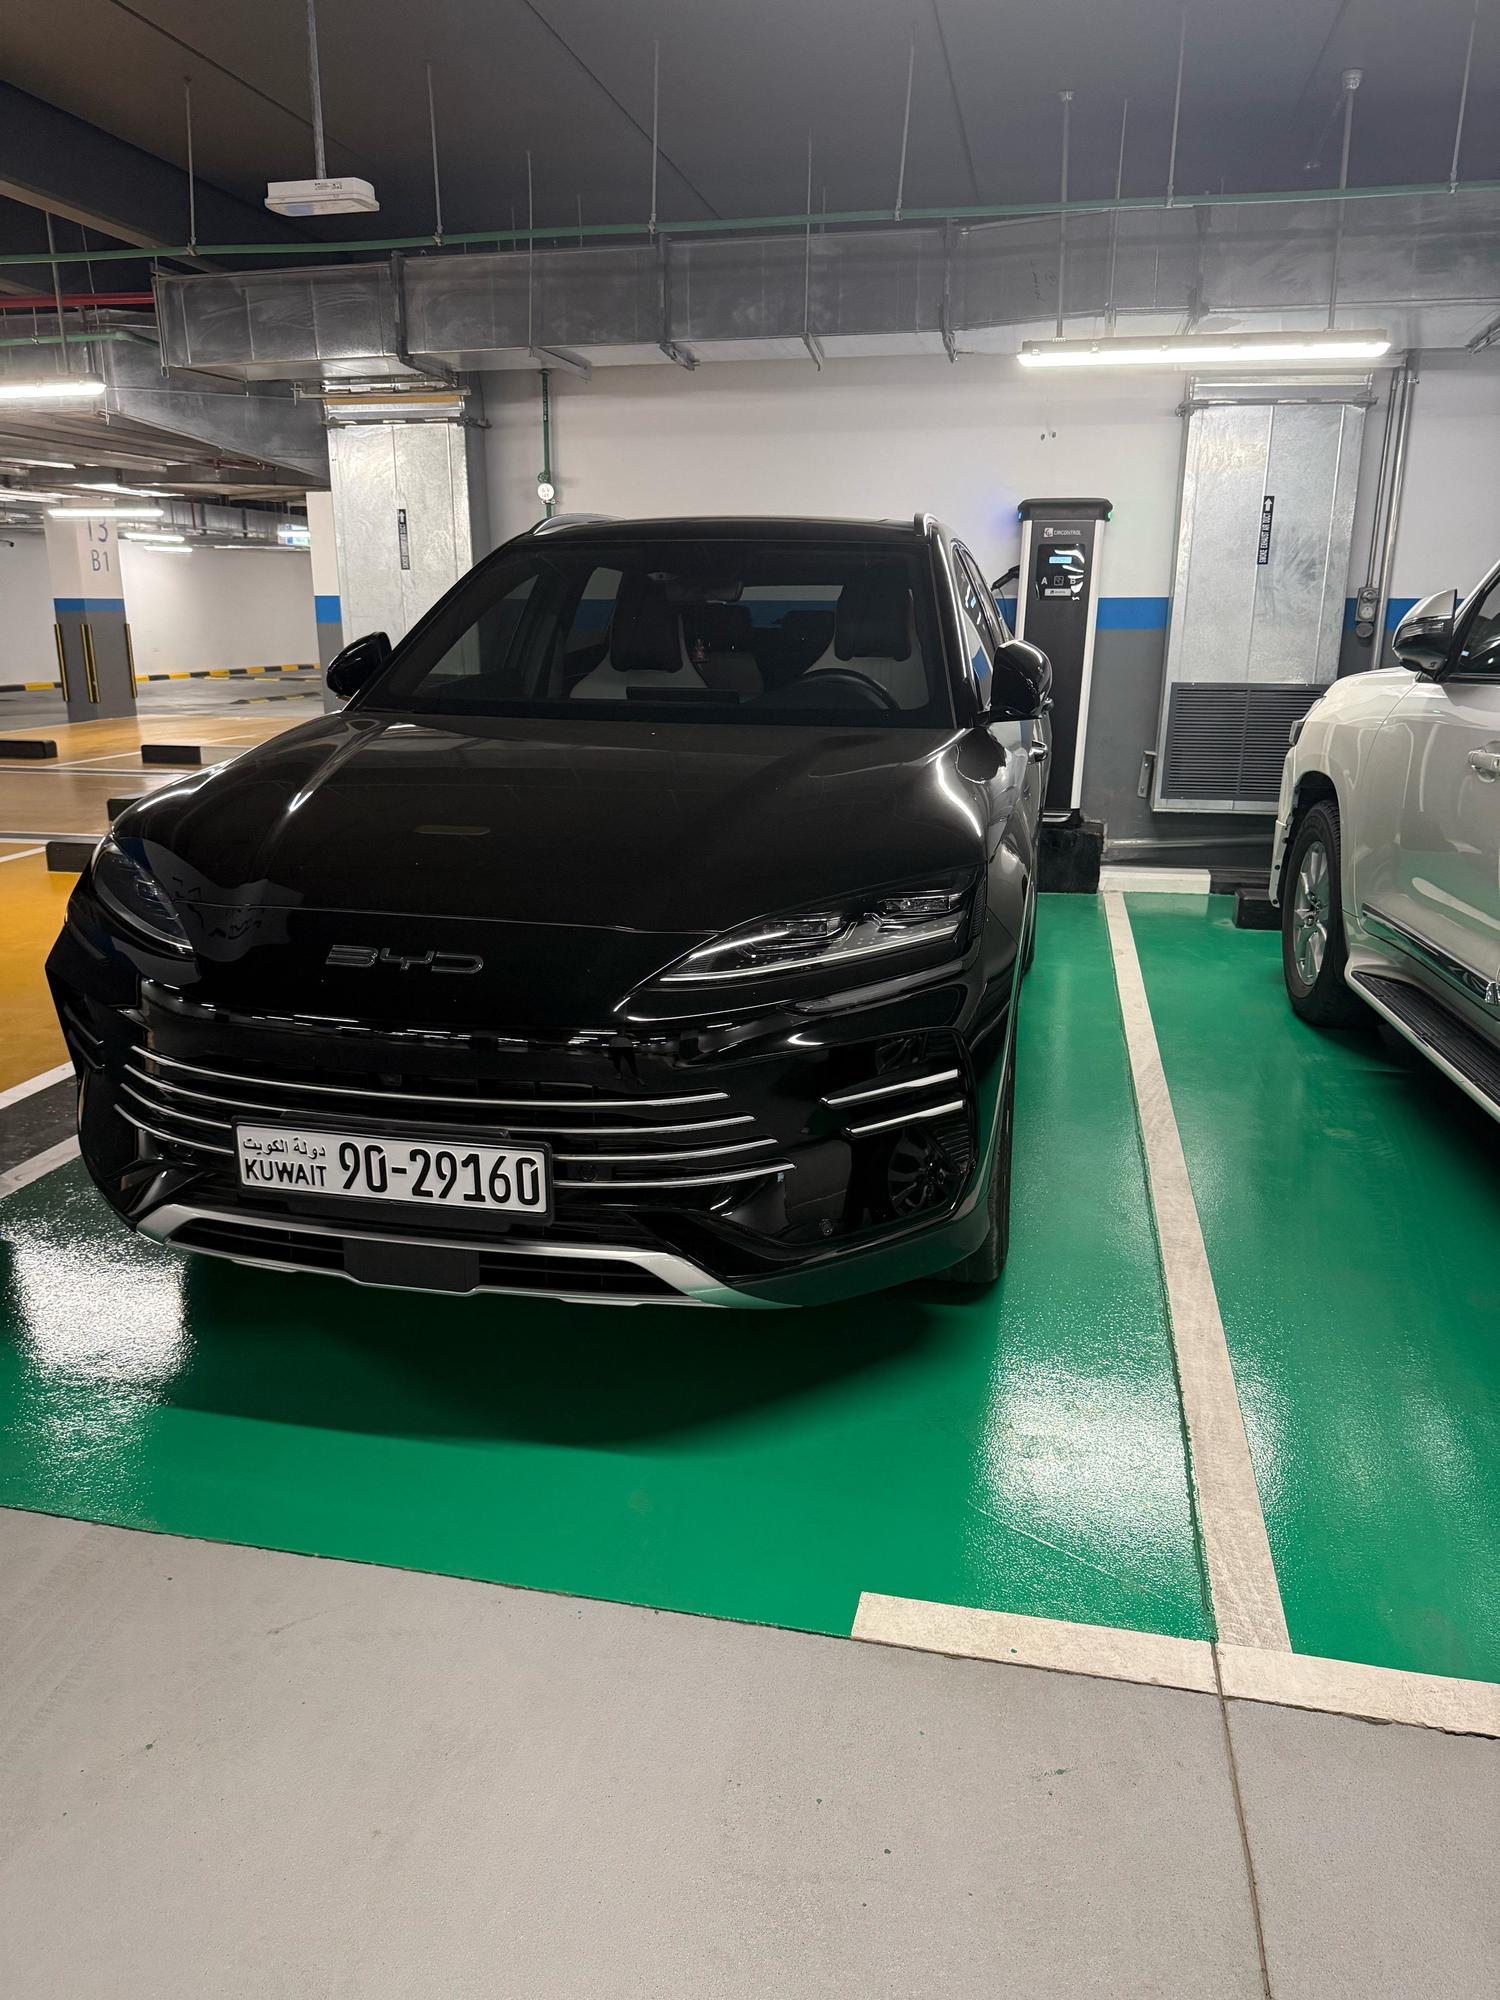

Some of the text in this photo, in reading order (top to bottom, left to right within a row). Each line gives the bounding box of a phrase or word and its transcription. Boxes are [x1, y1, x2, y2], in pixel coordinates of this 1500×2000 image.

[91, 549, 110, 572] B1
[1041, 577, 1048, 585] A
[325, 944, 484, 974] BYD
[243, 1137, 326, 1159] دولة الكويت
[244, 1158, 327, 1187] KUWAIT
[338, 1141, 541, 1206] 90-29160
